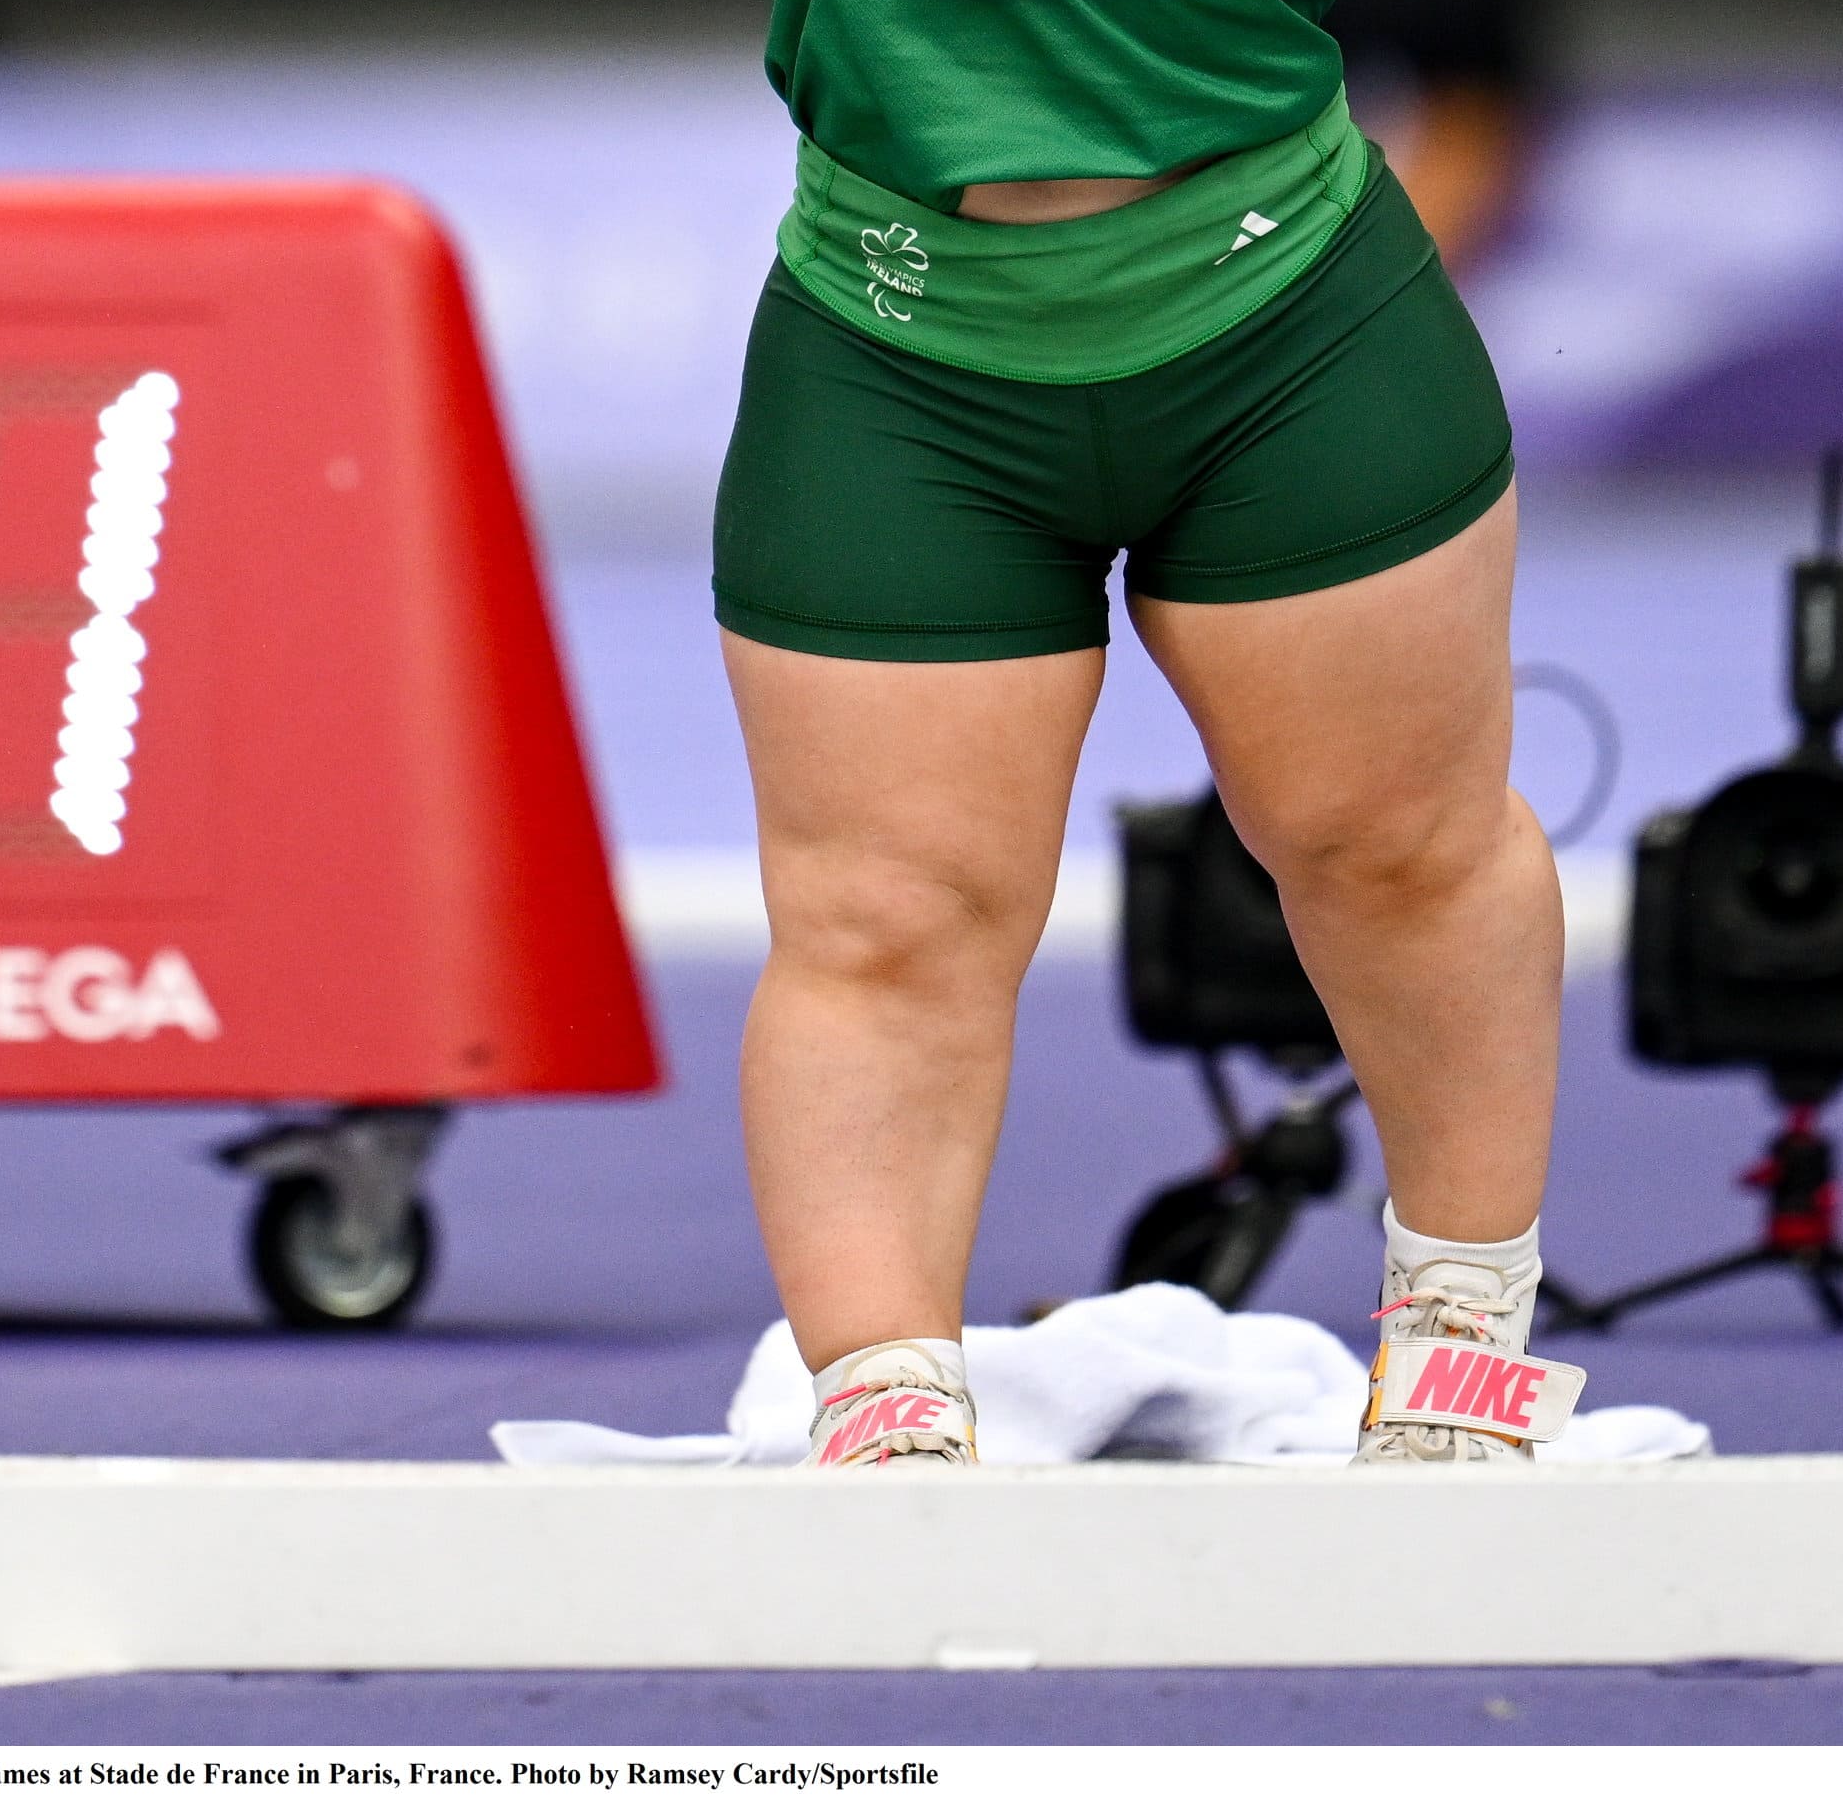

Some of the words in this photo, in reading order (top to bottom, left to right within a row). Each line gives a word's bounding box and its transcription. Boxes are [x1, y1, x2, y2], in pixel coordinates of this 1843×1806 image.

[865, 258, 924, 297] IRELAND
[1406, 1347, 1547, 1429] NIKE
[818, 1393, 949, 1467] NIKE
